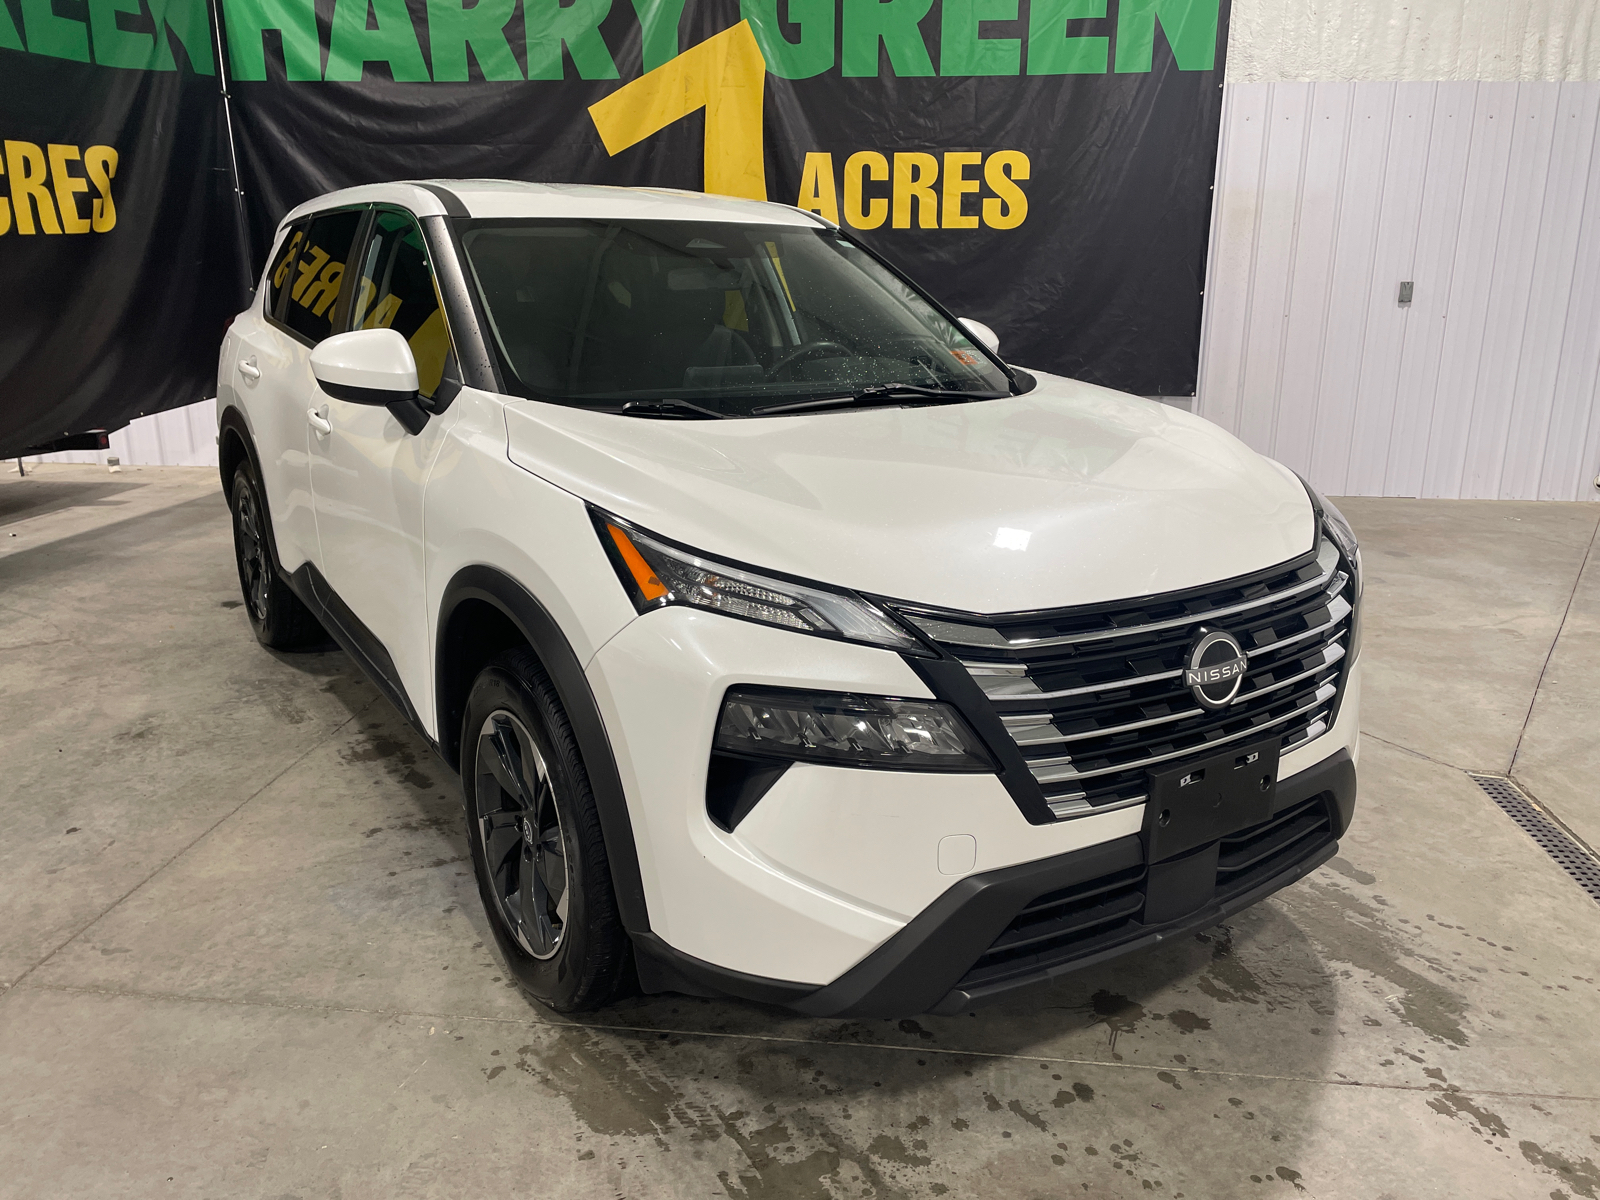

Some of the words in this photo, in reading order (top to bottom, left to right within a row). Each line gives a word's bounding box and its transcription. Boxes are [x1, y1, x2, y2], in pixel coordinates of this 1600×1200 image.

[0, 0, 215, 76] EEN
[222, 0, 685, 82] HARRY
[739, 0, 1219, 80] GREEN
[0, 140, 119, 236] RES
[797, 150, 1031, 230] ACRES
[1188, 659, 1247, 684] NISSAN
